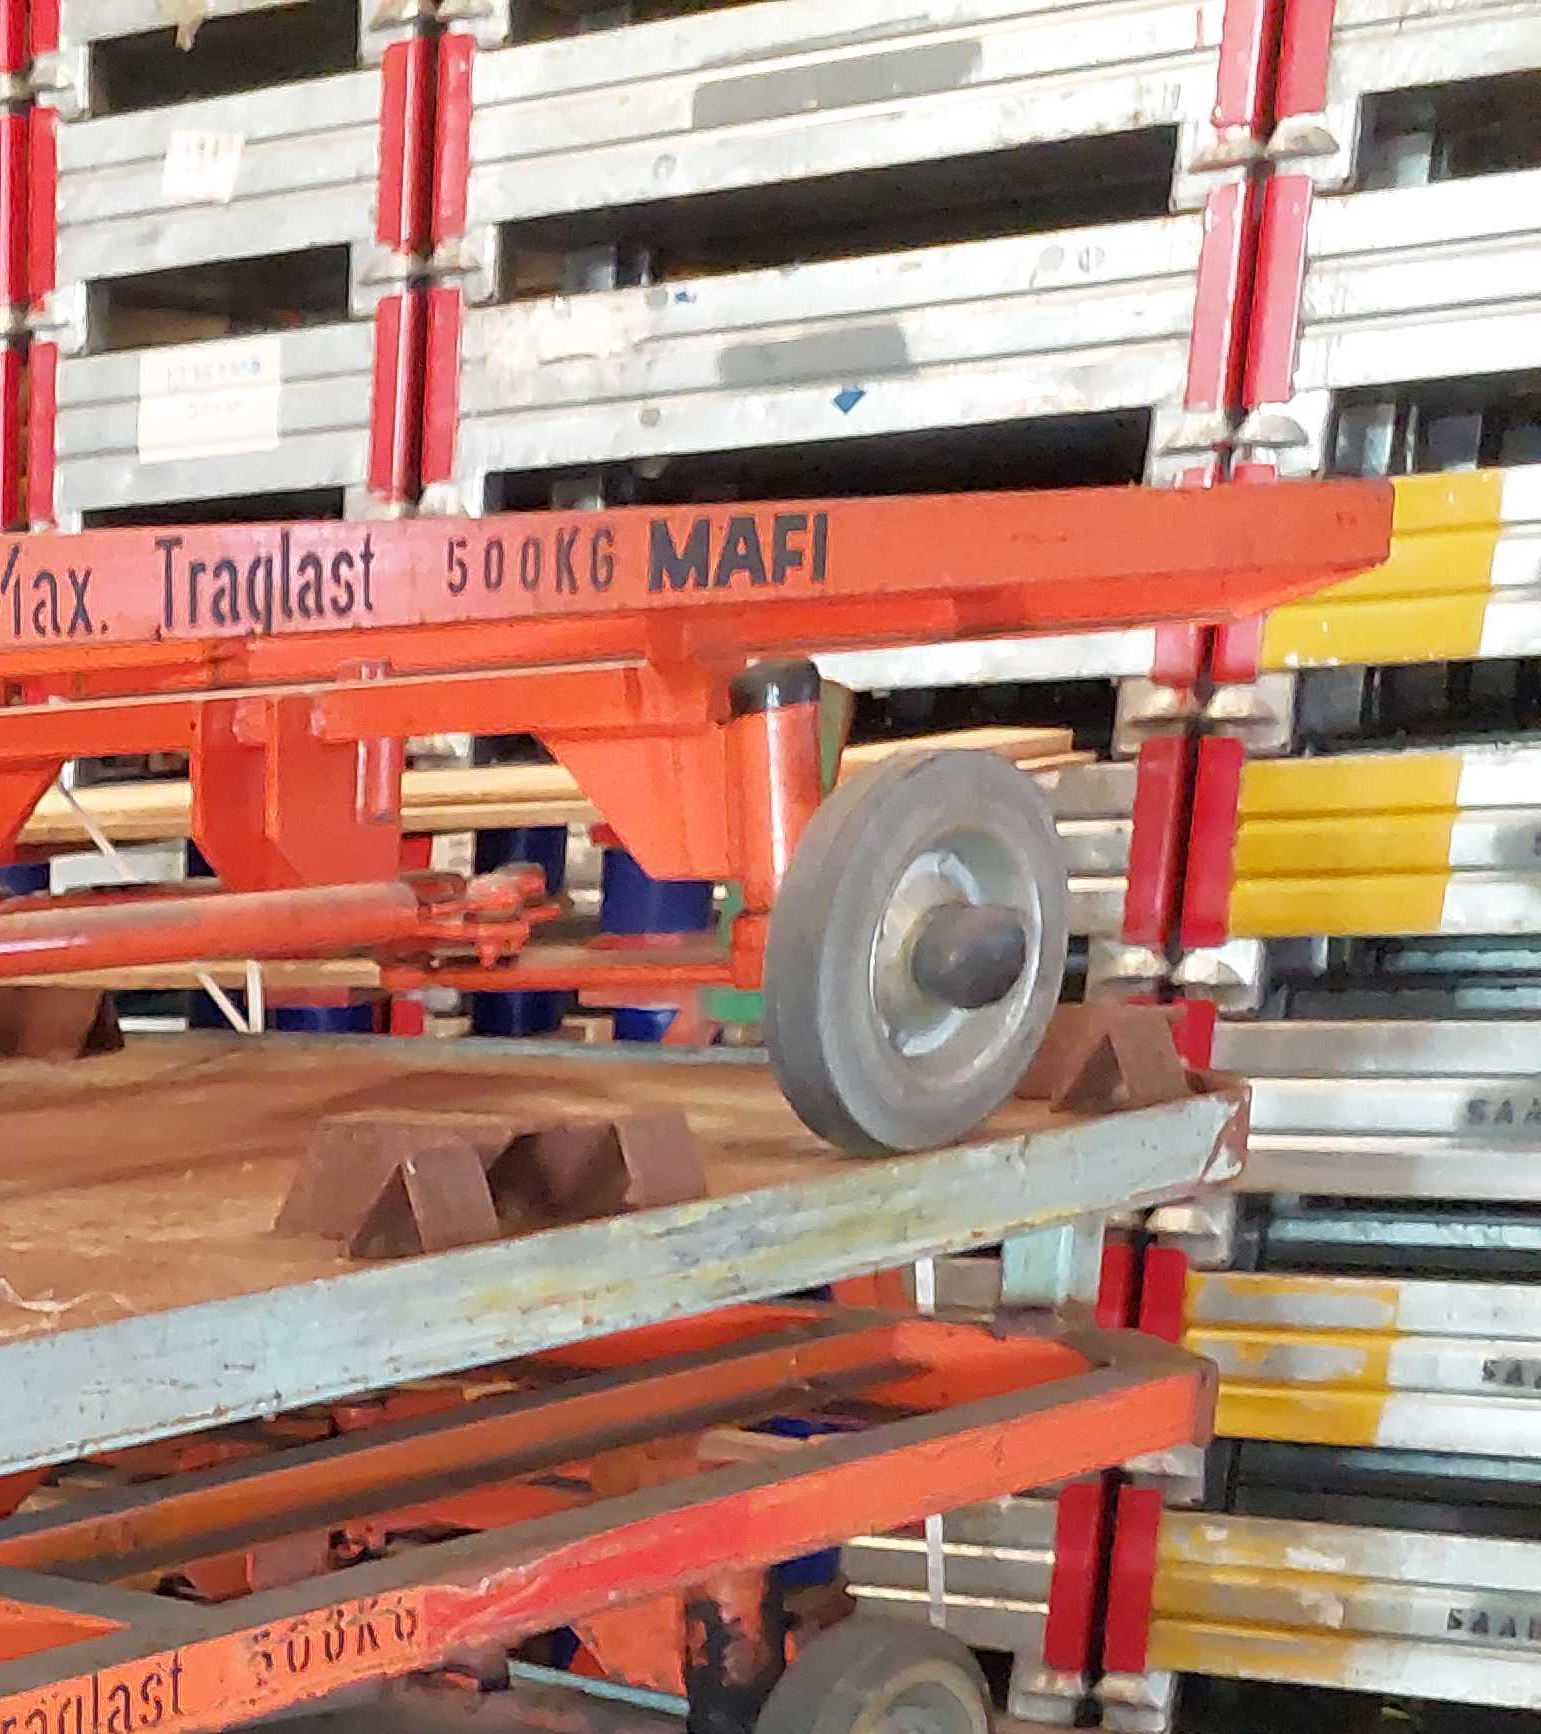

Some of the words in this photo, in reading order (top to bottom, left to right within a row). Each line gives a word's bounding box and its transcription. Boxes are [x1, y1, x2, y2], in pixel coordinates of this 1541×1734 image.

[447, 536, 615, 596] 500KG
[647, 513, 829, 593] MAFI
[1482, 1359, 1541, 1389] SA
